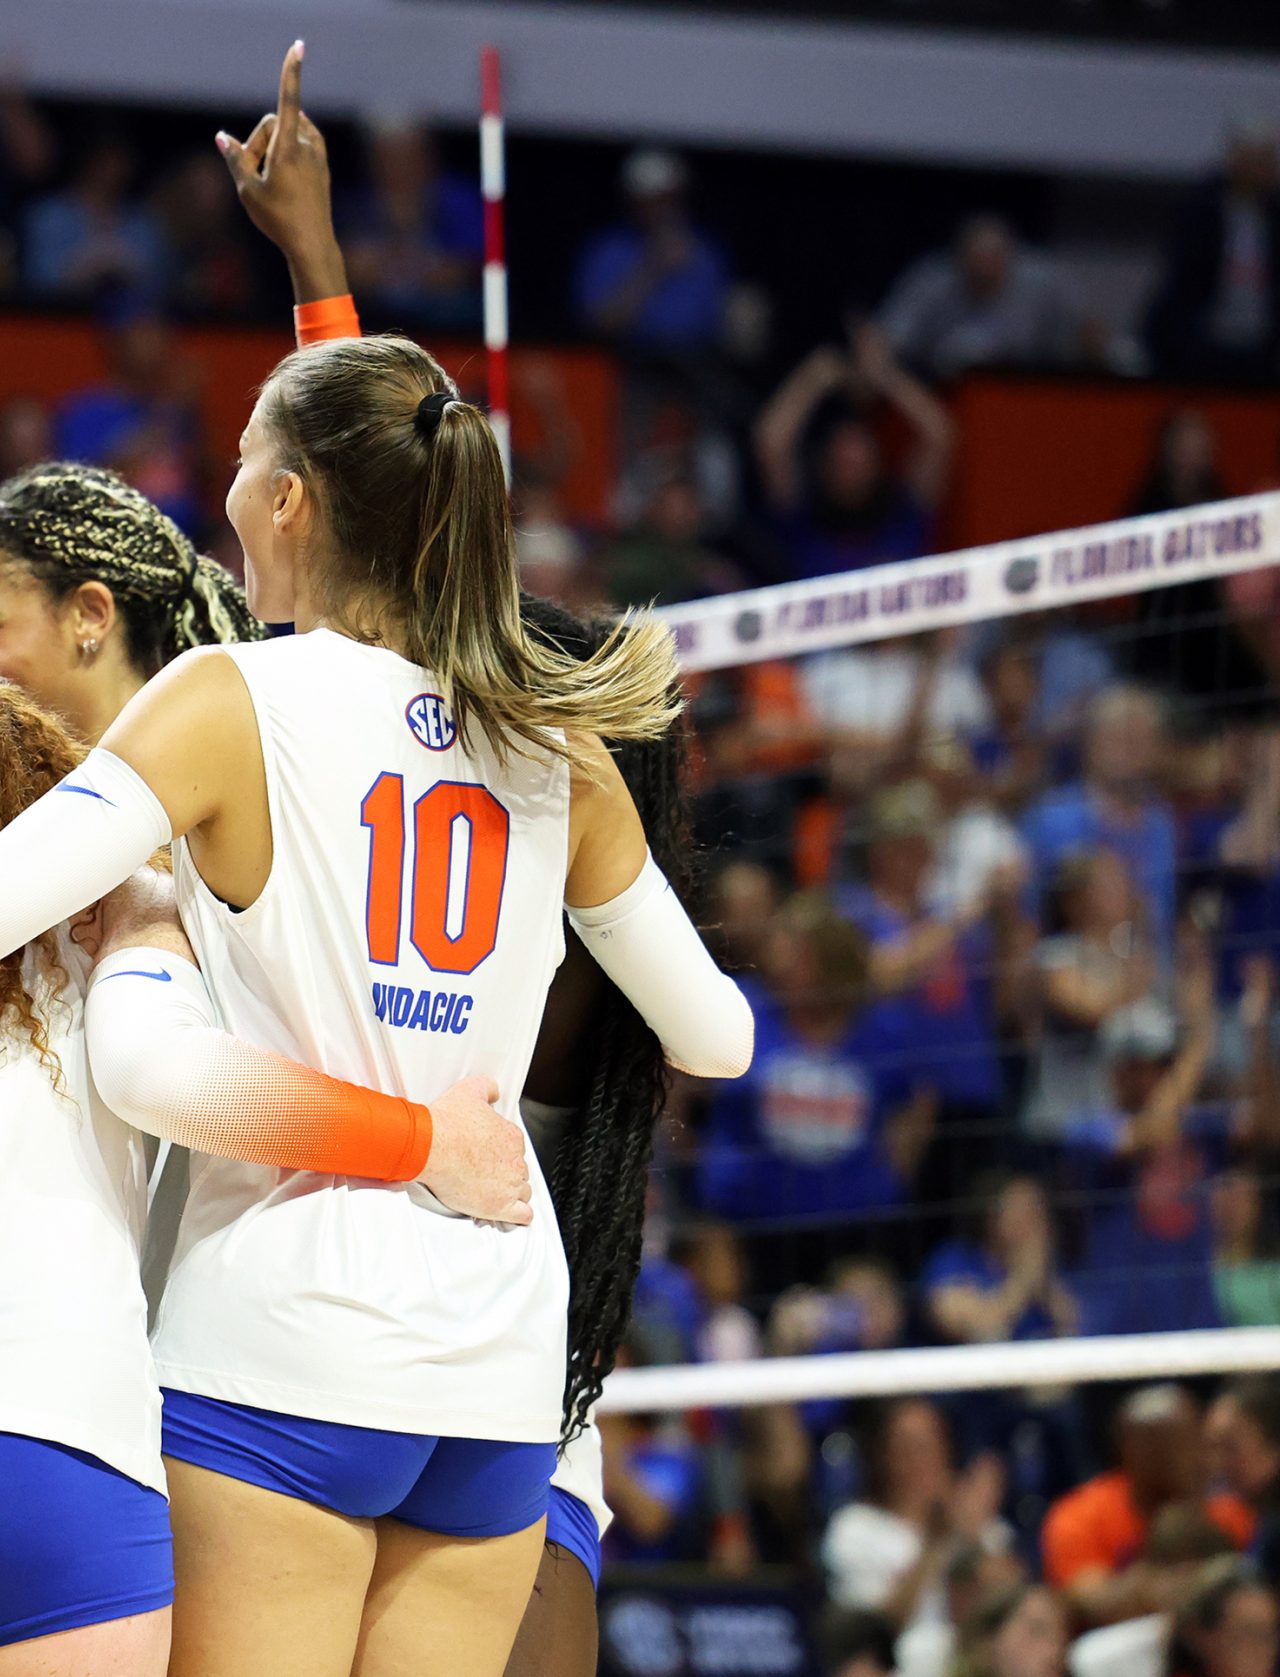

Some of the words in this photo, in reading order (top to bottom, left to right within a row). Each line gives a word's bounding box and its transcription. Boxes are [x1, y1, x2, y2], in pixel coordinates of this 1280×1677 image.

[1050, 535, 1154, 584] FLORIDA
[1163, 510, 1262, 565] GATORS
[408, 697, 455, 747] SEC
[360, 770, 510, 975] 10
